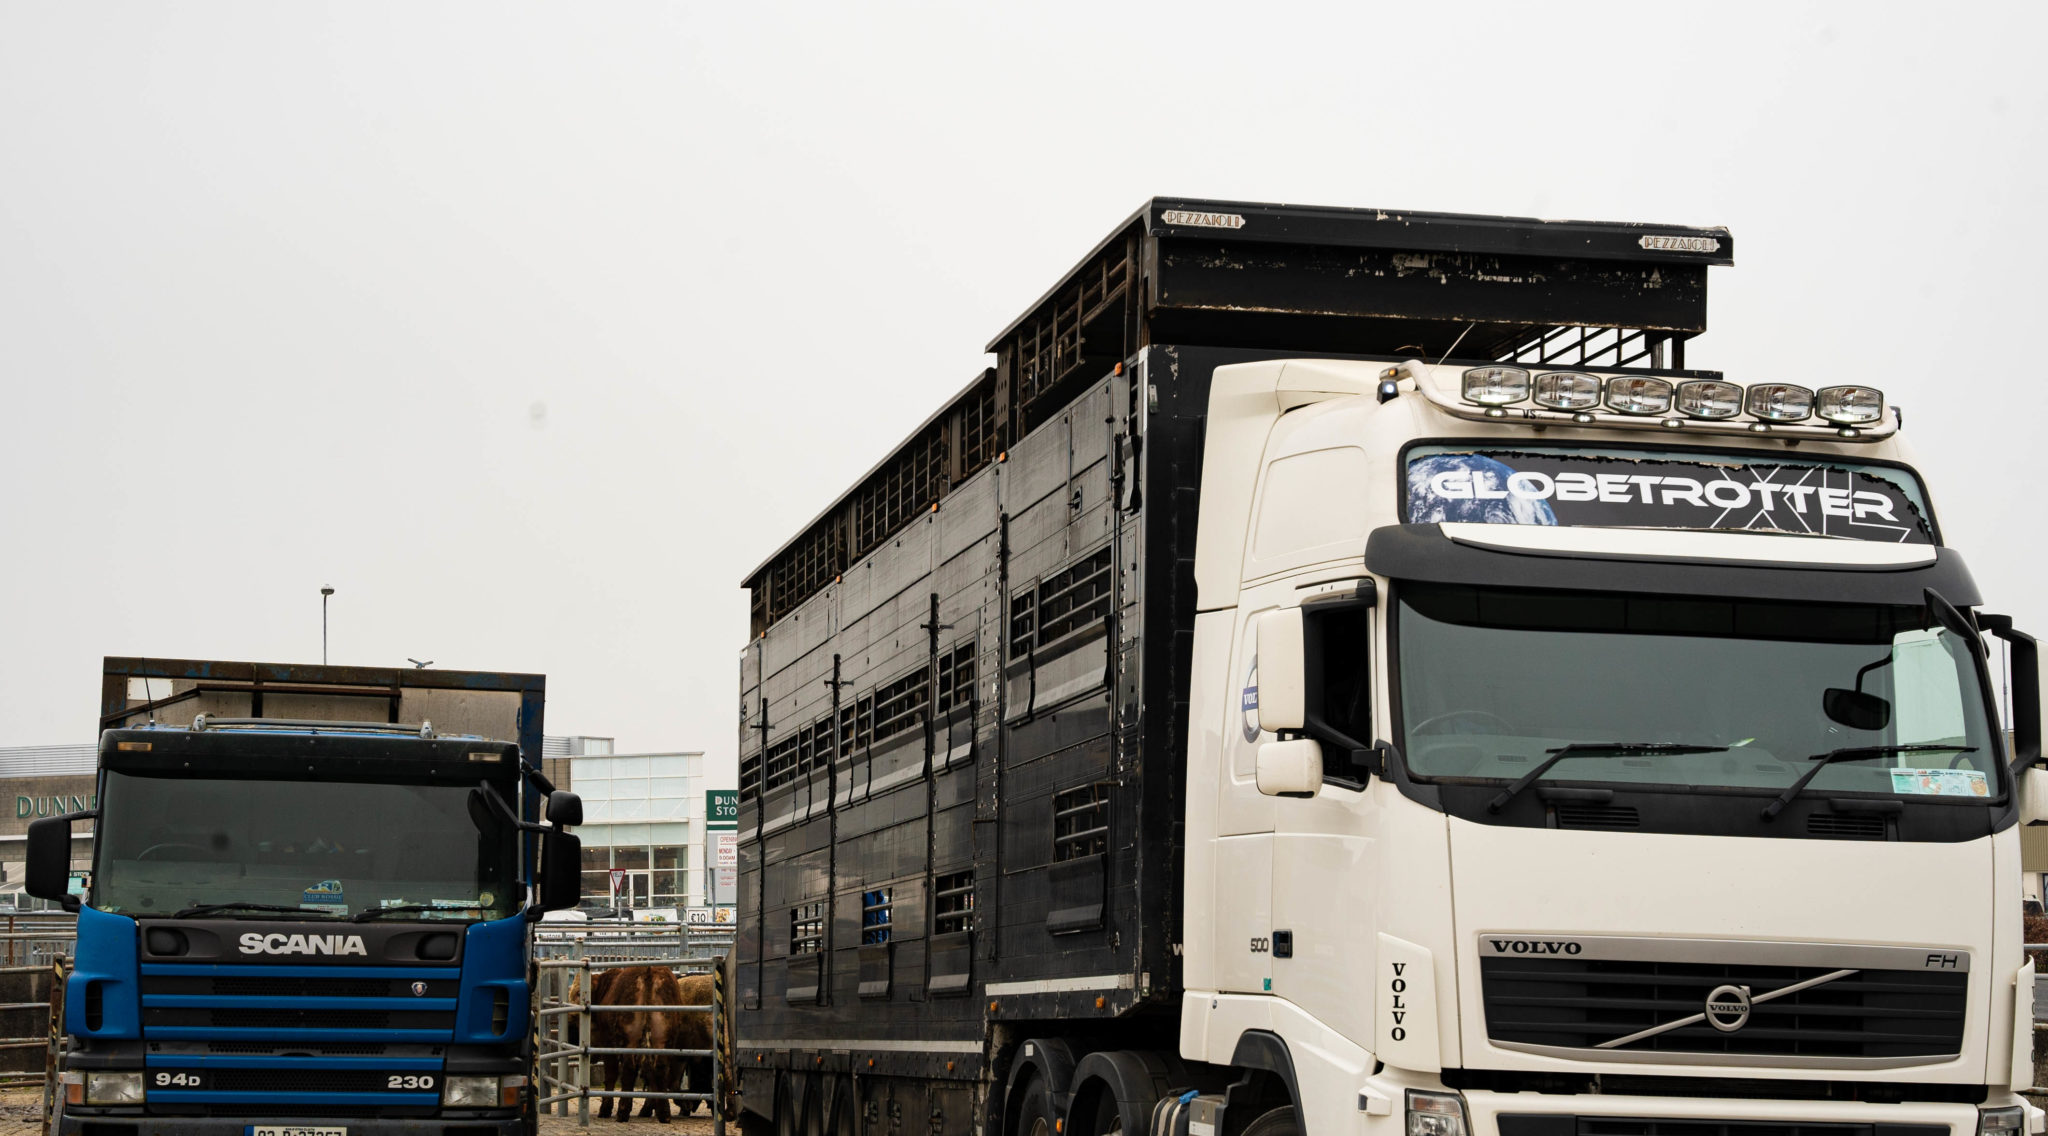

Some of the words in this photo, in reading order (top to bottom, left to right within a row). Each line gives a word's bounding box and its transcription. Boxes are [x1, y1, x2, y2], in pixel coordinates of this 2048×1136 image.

[1167, 211, 1240, 228] PEZZAIOLI
[1644, 236, 1716, 251] PEZZAIOLI
[1430, 471, 1895, 523] GLOBETROTTER
[716, 806, 737, 816] STO
[690, 912, 706, 923] €10
[238, 932, 368, 956] SCANIA
[1250, 937, 1269, 953] 500
[1489, 940, 1583, 955] VOLVO
[1925, 954, 1959, 969] FH
[1391, 962, 1407, 1042] VOLVO
[1708, 1004, 1749, 1013] VOLVO
[387, 1075, 435, 1089] 230
